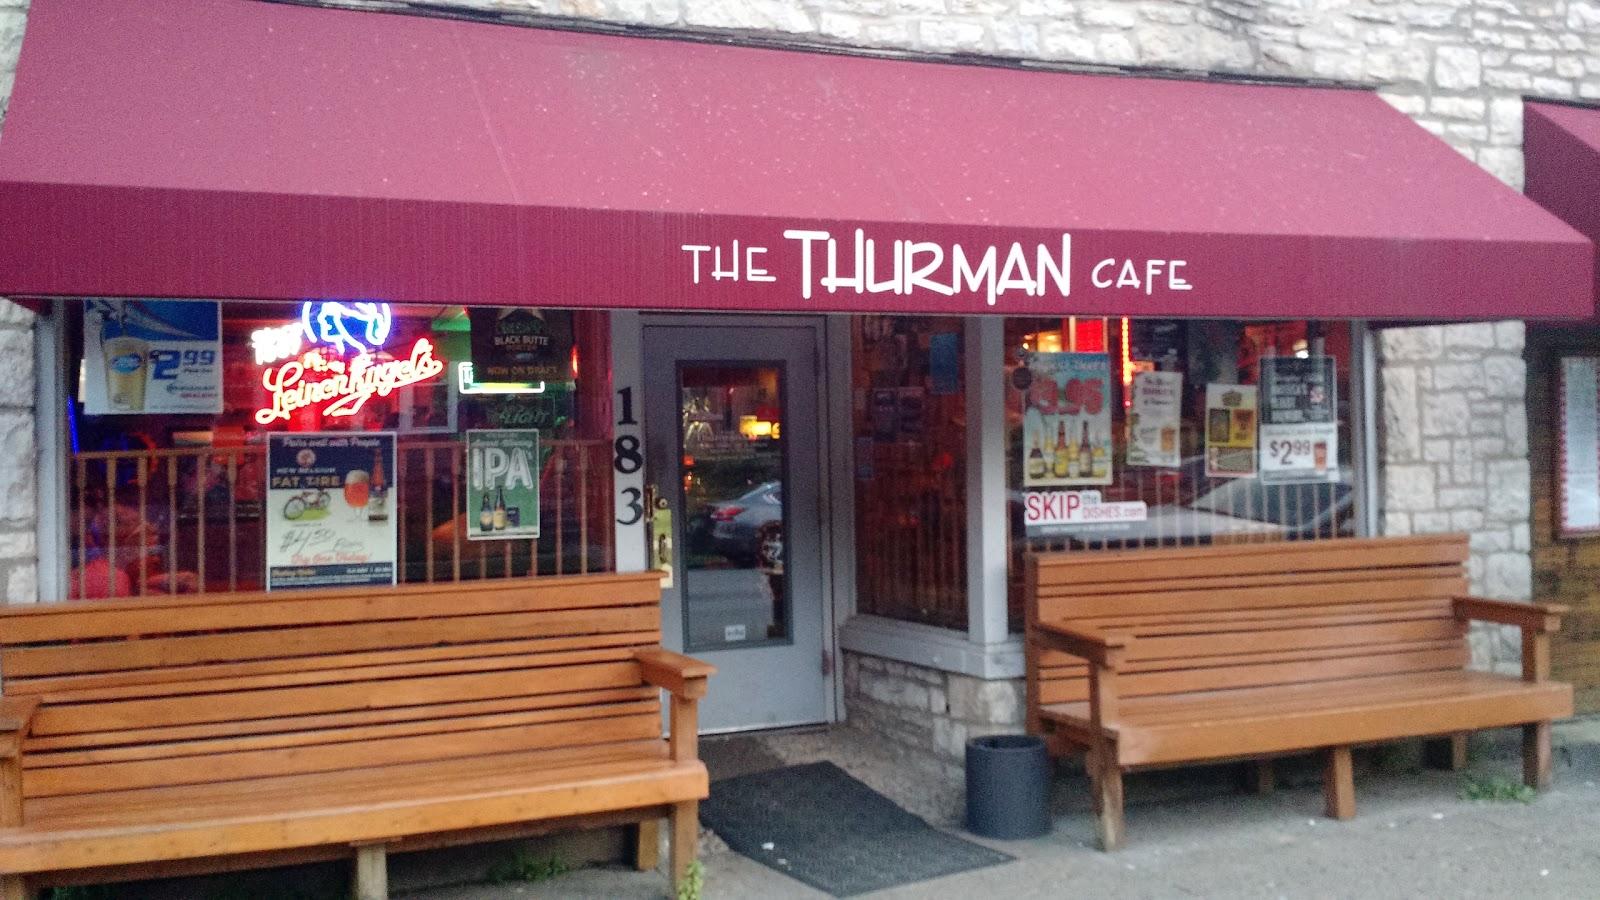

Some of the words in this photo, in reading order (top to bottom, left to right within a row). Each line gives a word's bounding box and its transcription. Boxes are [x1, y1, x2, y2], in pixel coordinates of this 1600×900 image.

[681, 239, 776, 284] THE
[783, 228, 1071, 305] THURMAN
[1091, 258, 1193, 295] CAFE
[494, 335, 521, 346] BLACK
[522, 335, 549, 346] BUTTE
[271, 476, 301, 487] FAT
[305, 475, 341, 487] TIRE
[472, 447, 534, 490] IPA
[1028, 493, 1080, 521] SKIP
